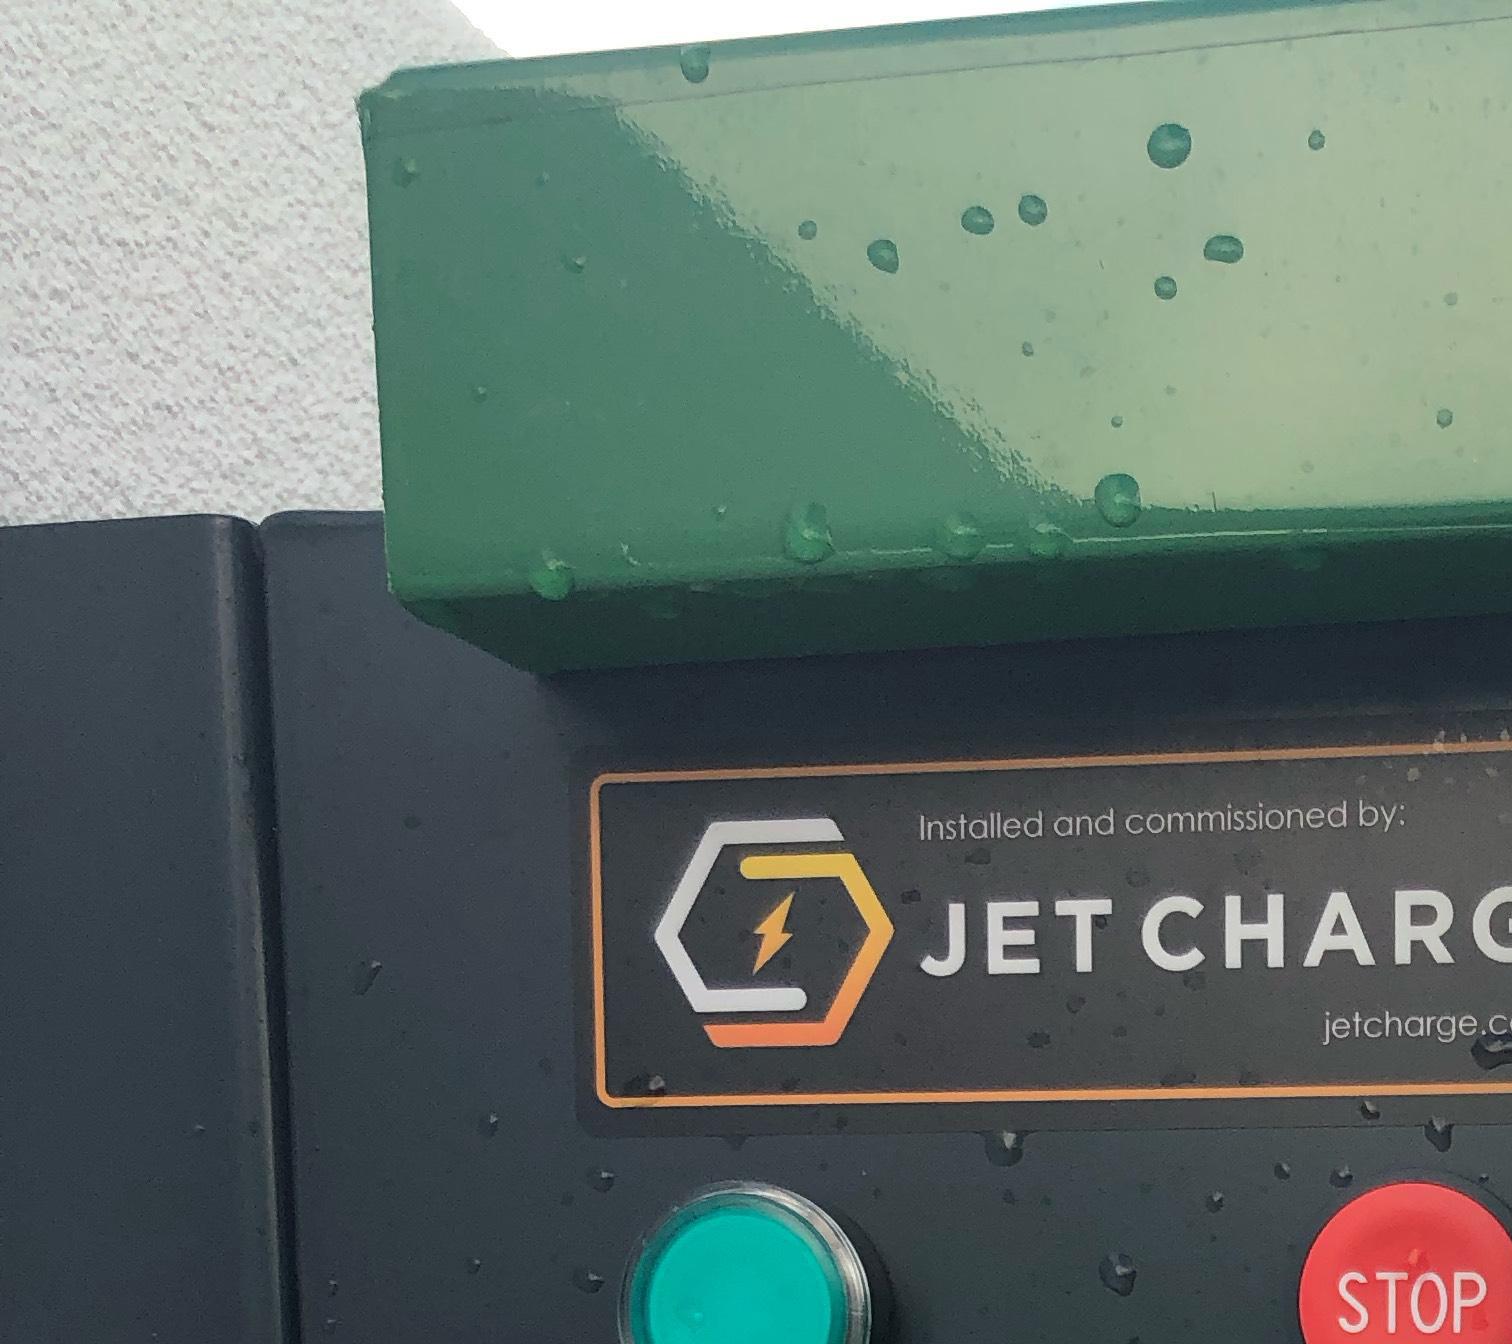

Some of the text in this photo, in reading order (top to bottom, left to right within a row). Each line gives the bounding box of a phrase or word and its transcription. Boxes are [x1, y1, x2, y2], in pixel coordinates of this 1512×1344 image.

[920, 799, 1406, 841] Installed and commissioned by:
[920, 898, 1113, 977] JET
[1337, 1271, 1488, 1335] STOP
